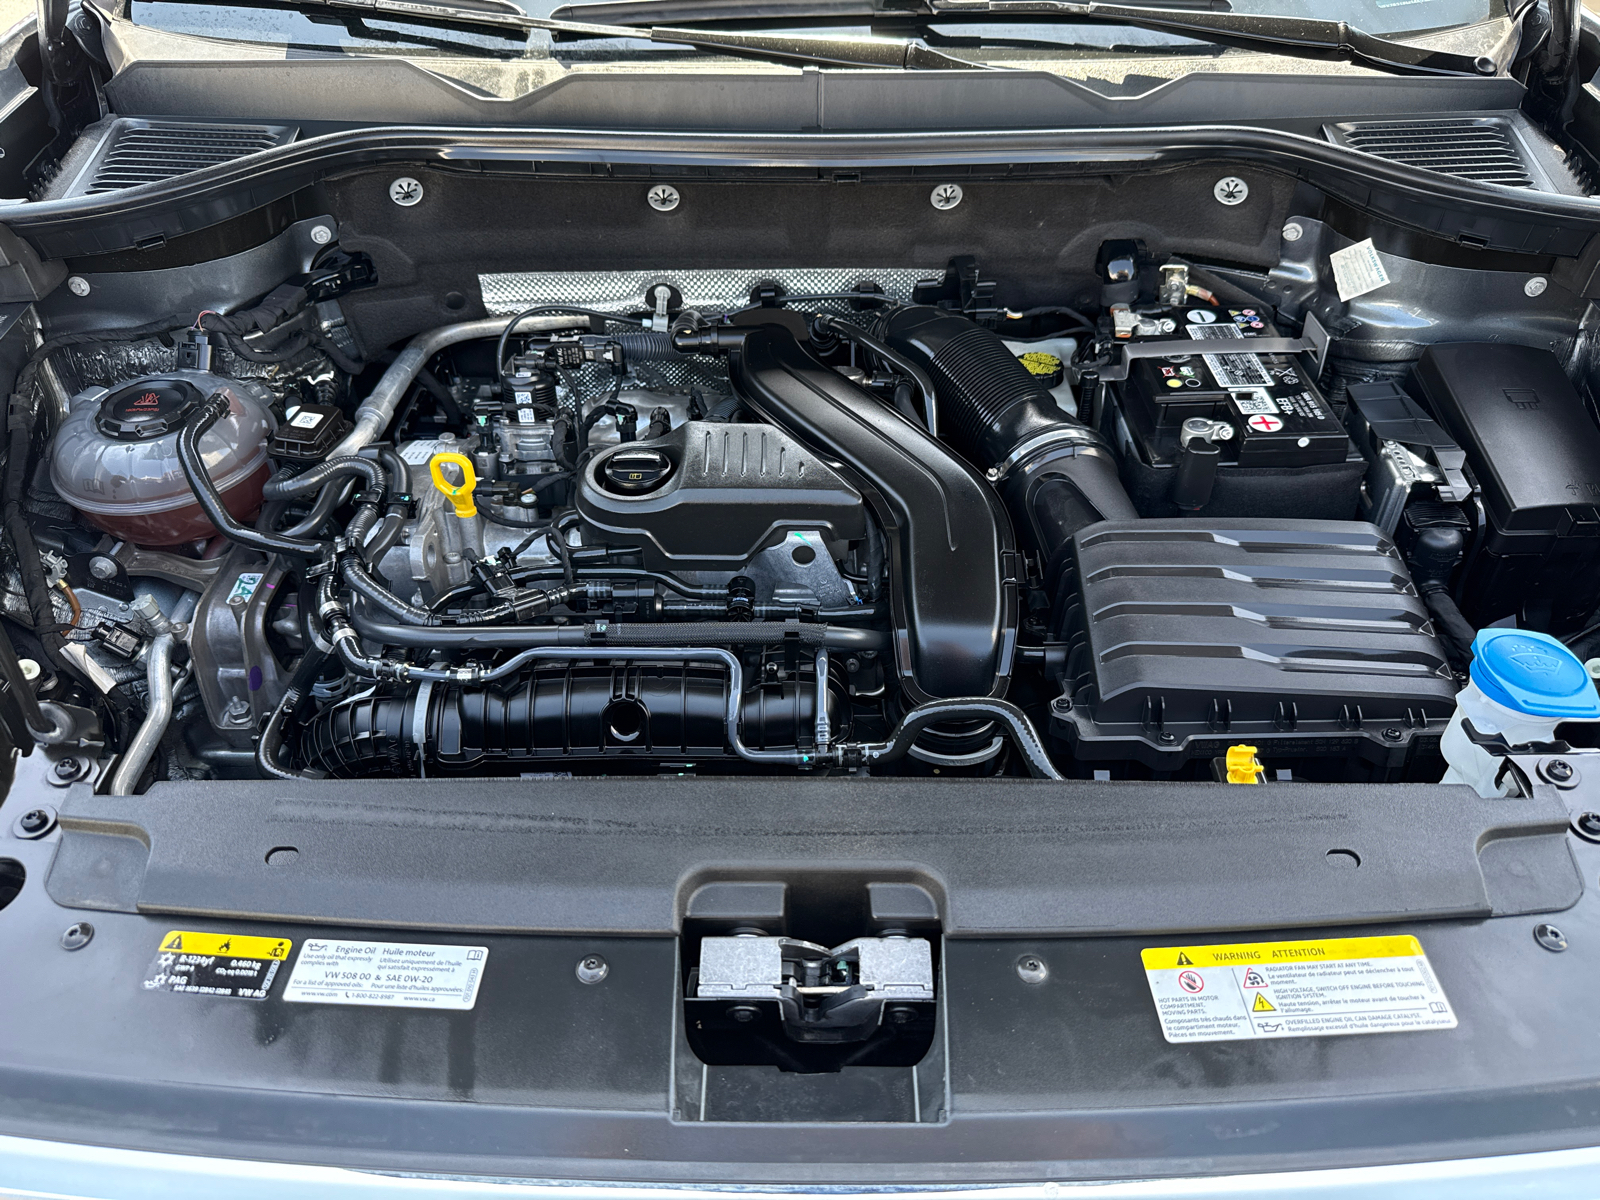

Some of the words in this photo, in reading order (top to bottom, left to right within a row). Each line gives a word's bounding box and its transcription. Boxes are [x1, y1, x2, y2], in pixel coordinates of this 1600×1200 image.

[1366, 246, 1384, 282] VOLKSWAGEN
[1276, 398, 1293, 414] EFB+
[336, 946, 363, 954] Engine
[1213, 951, 1261, 961] WARNING
[1272, 947, 1325, 958] ATTENTION
[179, 955, 215, 967] R-1234yf
[252, 961, 261, 970] kg
[168, 975, 188, 984] PAG
[238, 988, 253, 997] VW
[253, 989, 266, 998] AG
